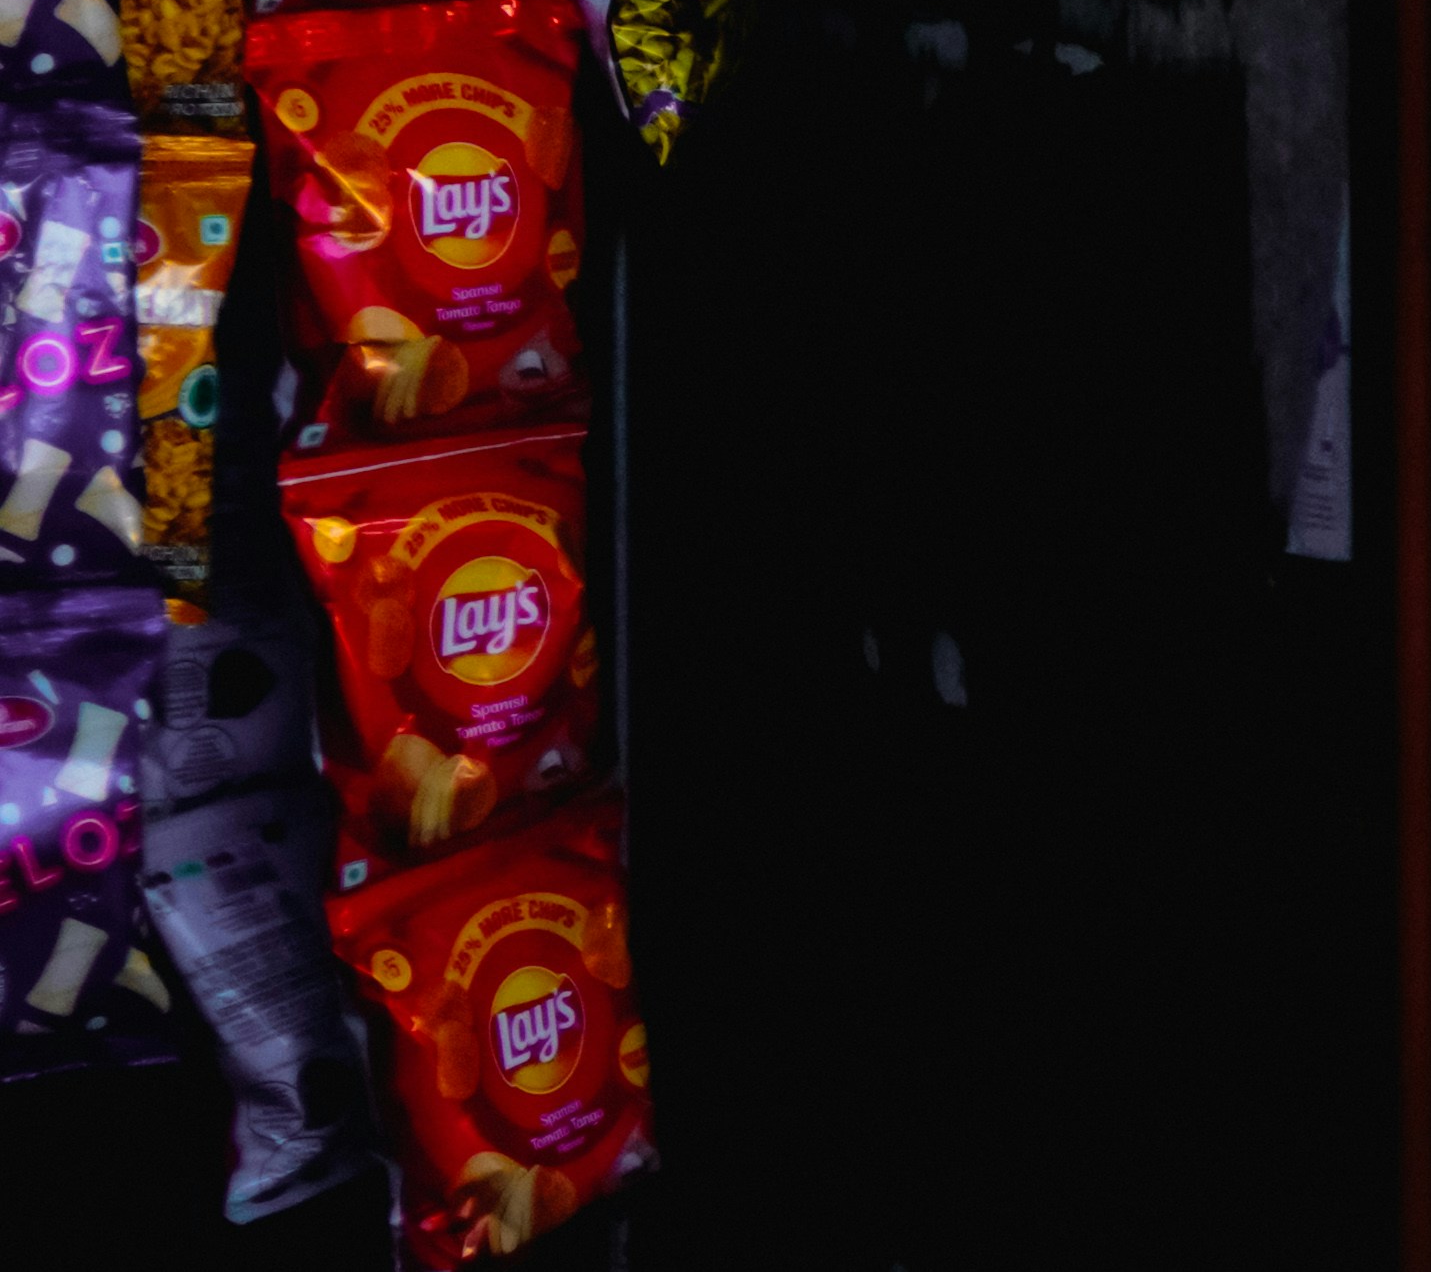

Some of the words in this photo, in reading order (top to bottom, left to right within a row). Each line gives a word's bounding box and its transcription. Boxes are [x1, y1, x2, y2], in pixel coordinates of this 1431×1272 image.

[368, 100, 405, 135] 25%
[403, 82, 456, 106] MORE
[461, 84, 517, 120] CHIPS
[422, 172, 512, 240] Lay's
[404, 521, 440, 557] 25%
[437, 497, 486, 523] MORE
[492, 498, 549, 526] CHIPS
[441, 581, 540, 657] Lay's
[454, 939, 483, 977] 25%
[478, 900, 525, 934] MORE
[528, 899, 576, 929] CHIPS
[497, 988, 577, 1072] Lay's
